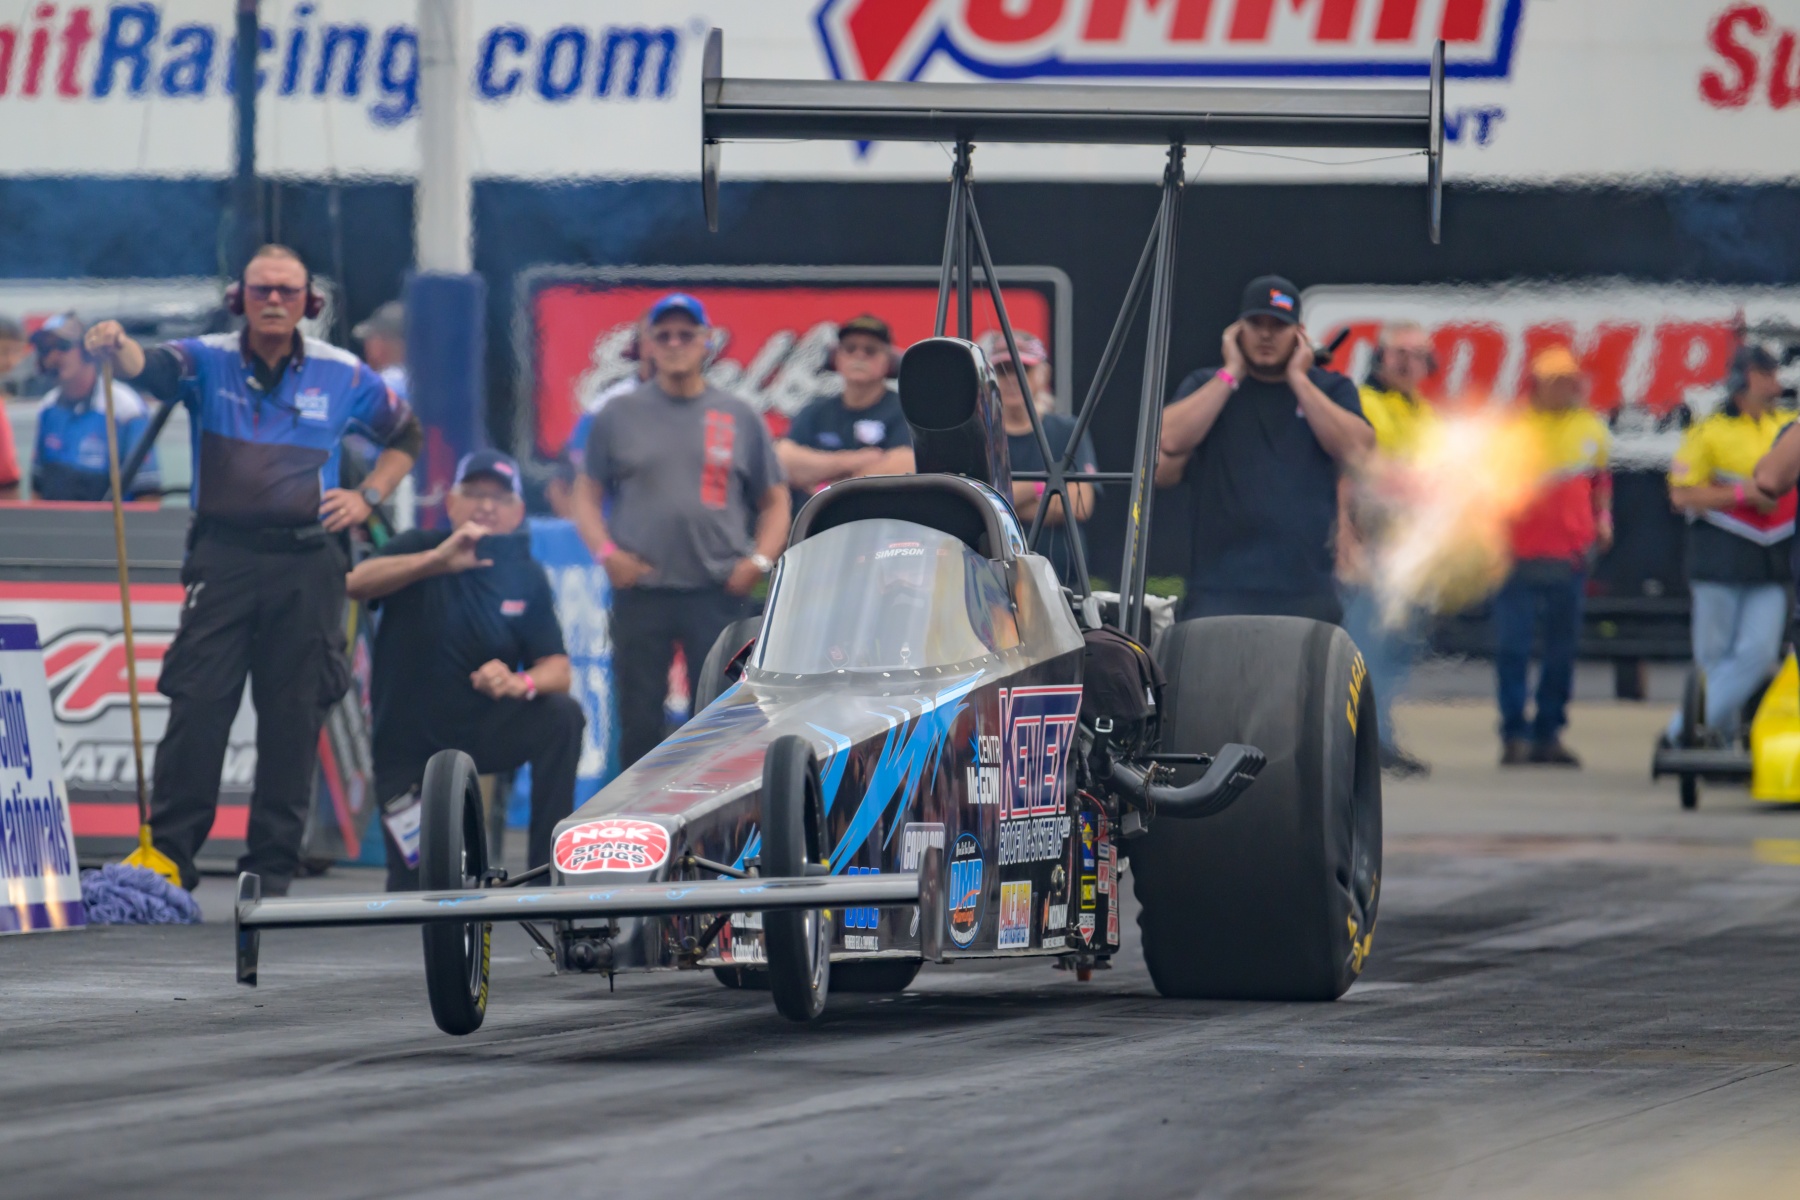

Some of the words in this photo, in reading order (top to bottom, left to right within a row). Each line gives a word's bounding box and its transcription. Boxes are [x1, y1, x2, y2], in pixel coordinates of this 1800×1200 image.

[875, 548, 924, 559] SIMPSON
[572, 826, 652, 844] NGK
[573, 842, 650, 856] SPARK
[571, 851, 645, 868] PLUGS
